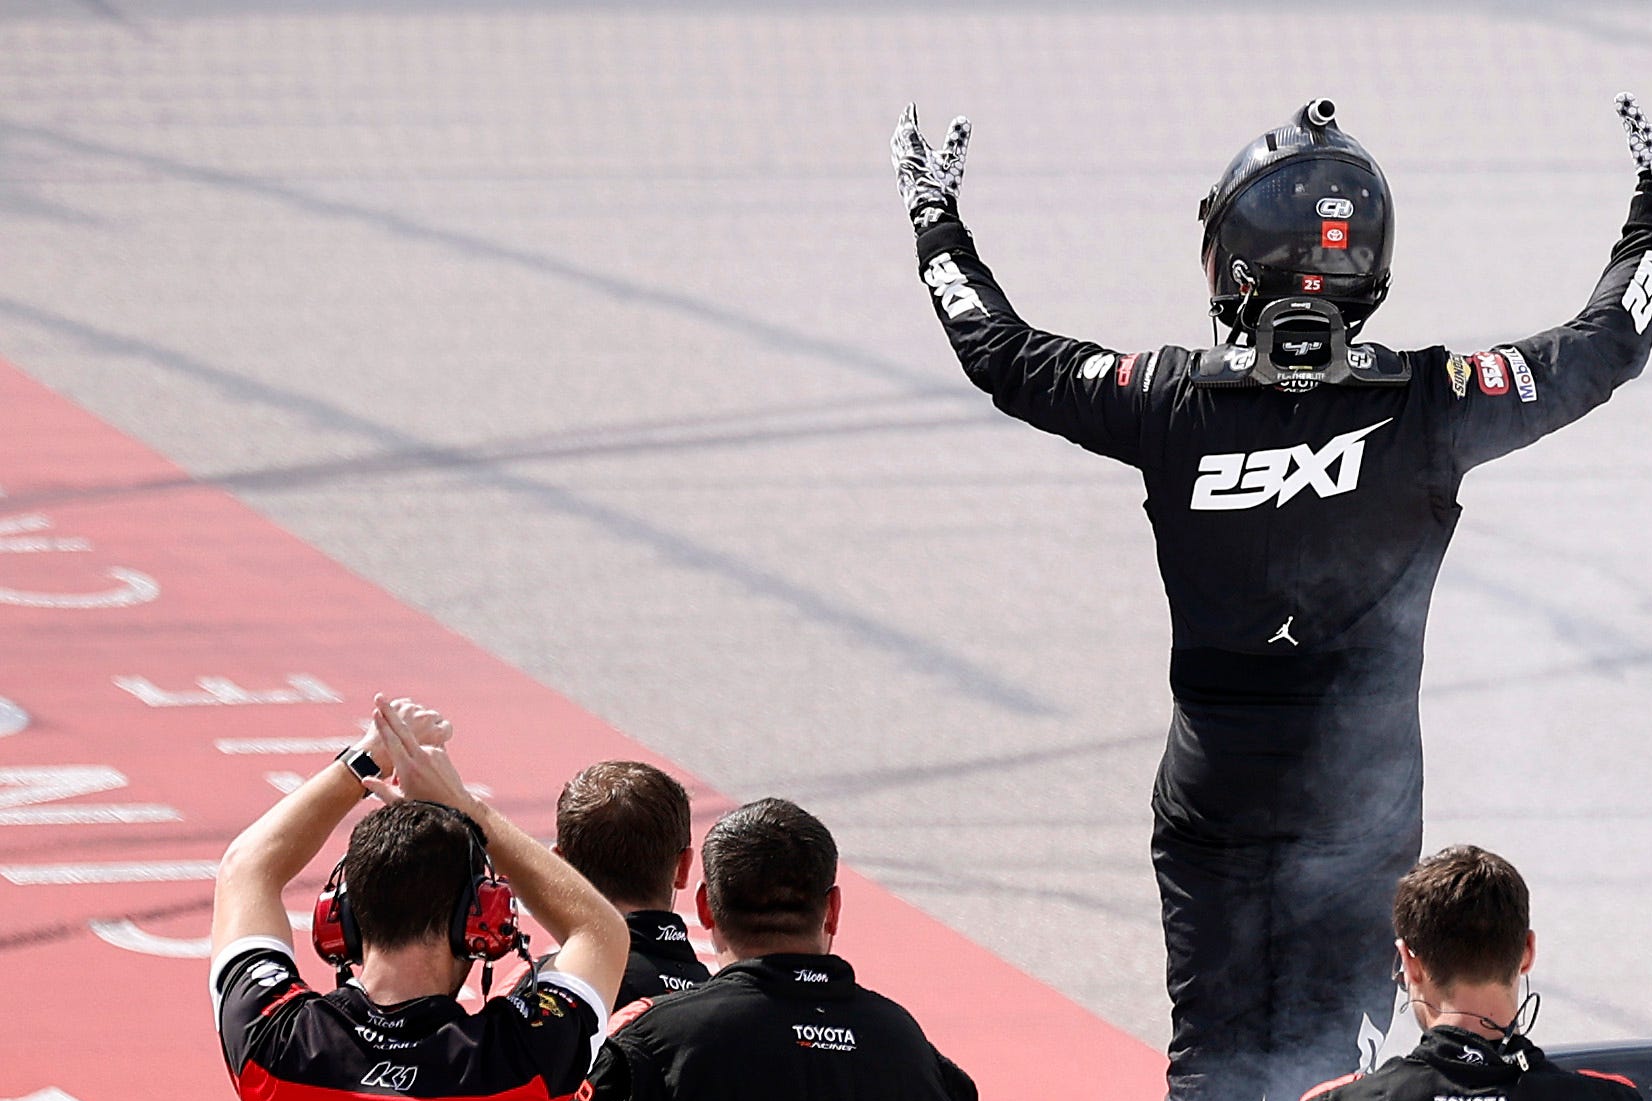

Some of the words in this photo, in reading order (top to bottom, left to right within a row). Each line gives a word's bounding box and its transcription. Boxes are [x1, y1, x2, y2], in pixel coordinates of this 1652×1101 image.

[1303, 280, 1321, 290] 25
[655, 925, 687, 941] Tricon
[793, 969, 829, 984] Tricon
[792, 1024, 856, 1044] TOYOTA
